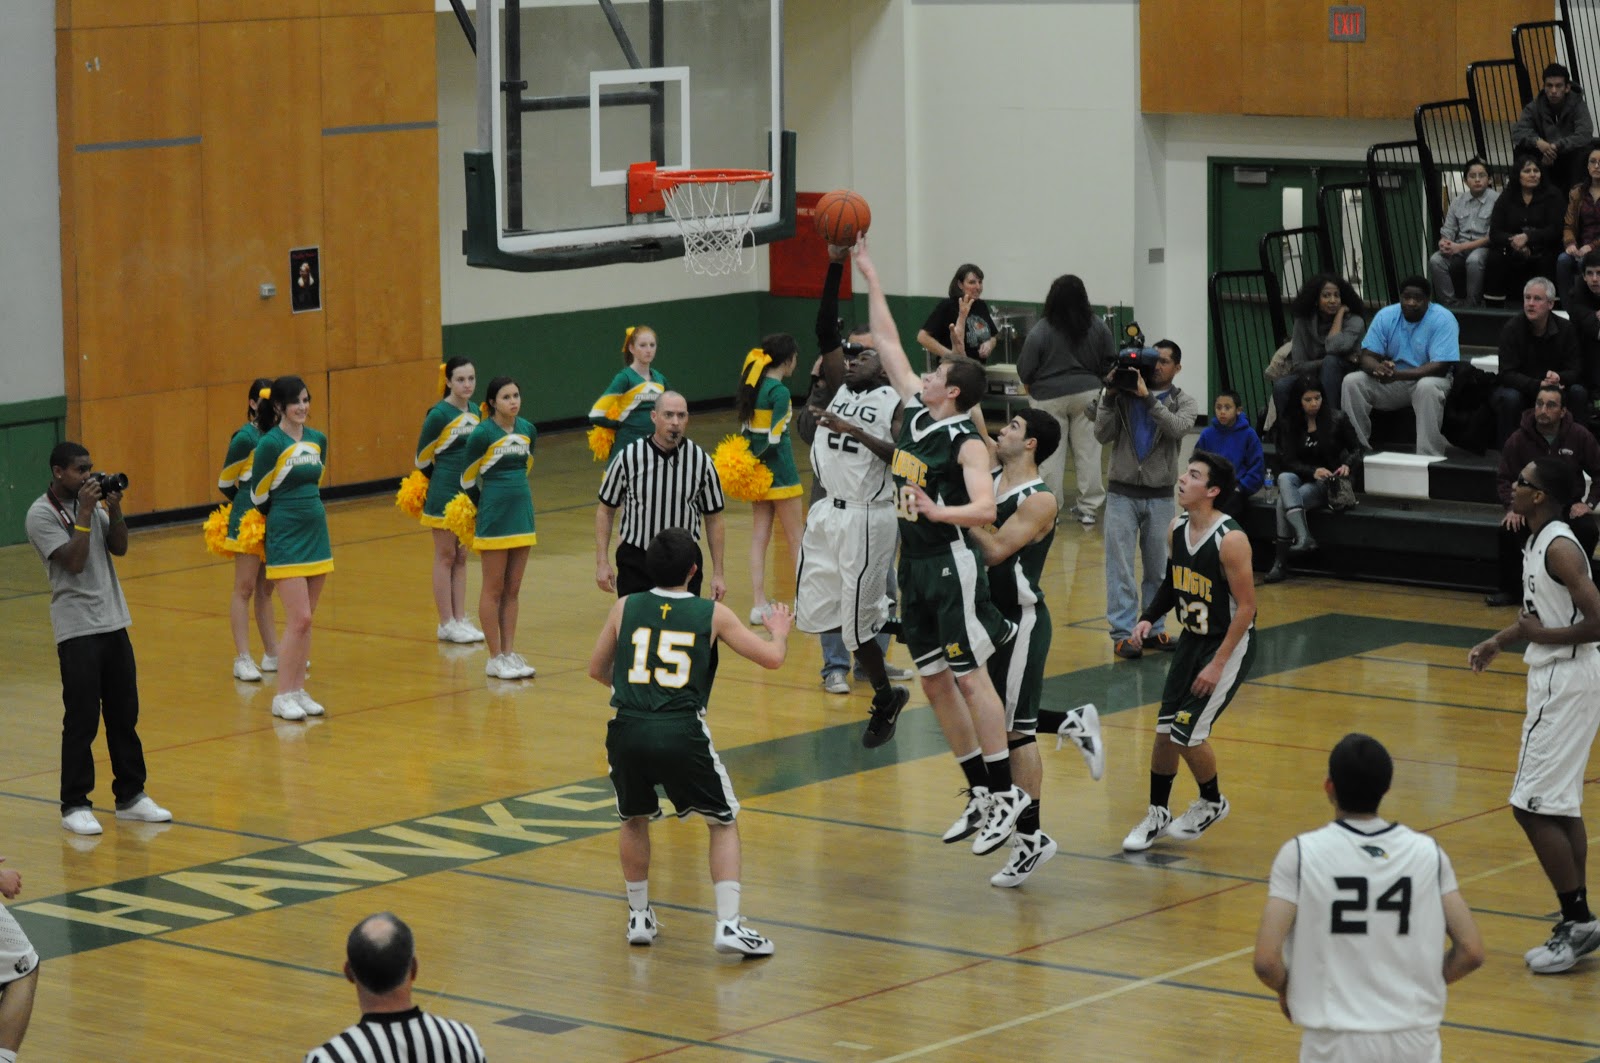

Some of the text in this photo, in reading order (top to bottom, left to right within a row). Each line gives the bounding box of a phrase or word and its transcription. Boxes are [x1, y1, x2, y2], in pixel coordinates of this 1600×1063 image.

[1333, 12, 1361, 35] EXIT
[831, 399, 878, 424] HUG
[1178, 596, 1209, 636] 23
[628, 626, 696, 689] 15
[1330, 876, 1412, 935] 24
